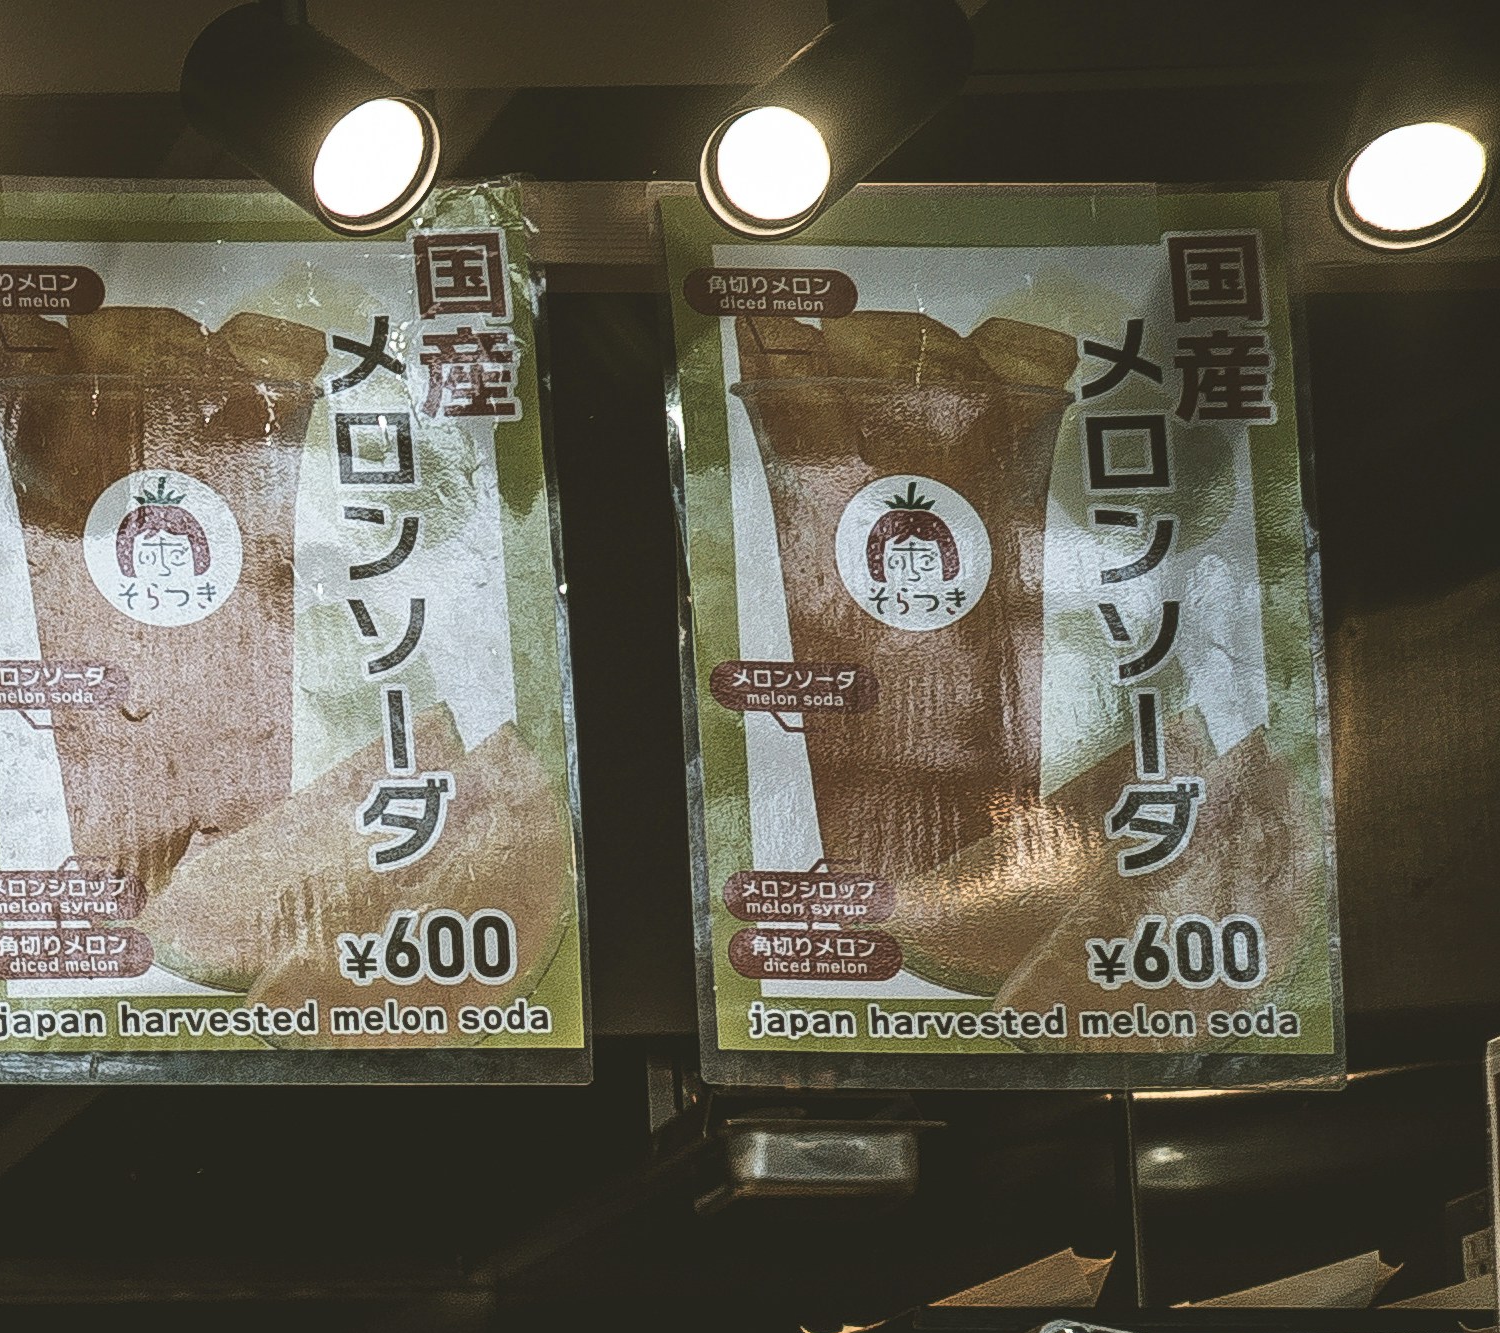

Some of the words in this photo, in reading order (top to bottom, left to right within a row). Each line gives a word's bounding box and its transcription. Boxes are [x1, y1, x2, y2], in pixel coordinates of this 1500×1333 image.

[708, 276, 831, 294] 角切りメロン
[19, 294, 70, 308] melon
[720, 296, 766, 309] diced
[773, 298, 824, 311] melon
[416, 232, 517, 418] 国産
[1171, 233, 1271, 421] 国産
[118, 581, 217, 610] そらつき
[333, 316, 448, 868] メロンソーダ
[868, 587, 966, 615] そらつき
[1083, 318, 1199, 873] メロンソーダ
[52, 689, 93, 703] soda
[747, 691, 797, 705] melon
[803, 692, 844, 706] soda
[60, 902, 117, 918] syrup
[746, 901, 804, 915] melon
[811, 903, 867, 916] syrup
[346, 911, 511, 981] ¥600
[752, 936, 876, 957] 角切りメロン
[1094, 919, 1260, 986] ¥600
[10, 957, 59, 972] diced
[65, 957, 118, 972] melon
[764, 958, 810, 973] diced
[817, 959, 868, 974] melon
[119, 1001, 317, 1033] harvested
[333, 1001, 446, 1033] melon
[459, 1000, 551, 1032] soda
[750, 1004, 854, 1038] japan
[870, 1006, 1065, 1037] harvested
[1081, 1006, 1195, 1038] melon
[1209, 1008, 1300, 1038] soda
